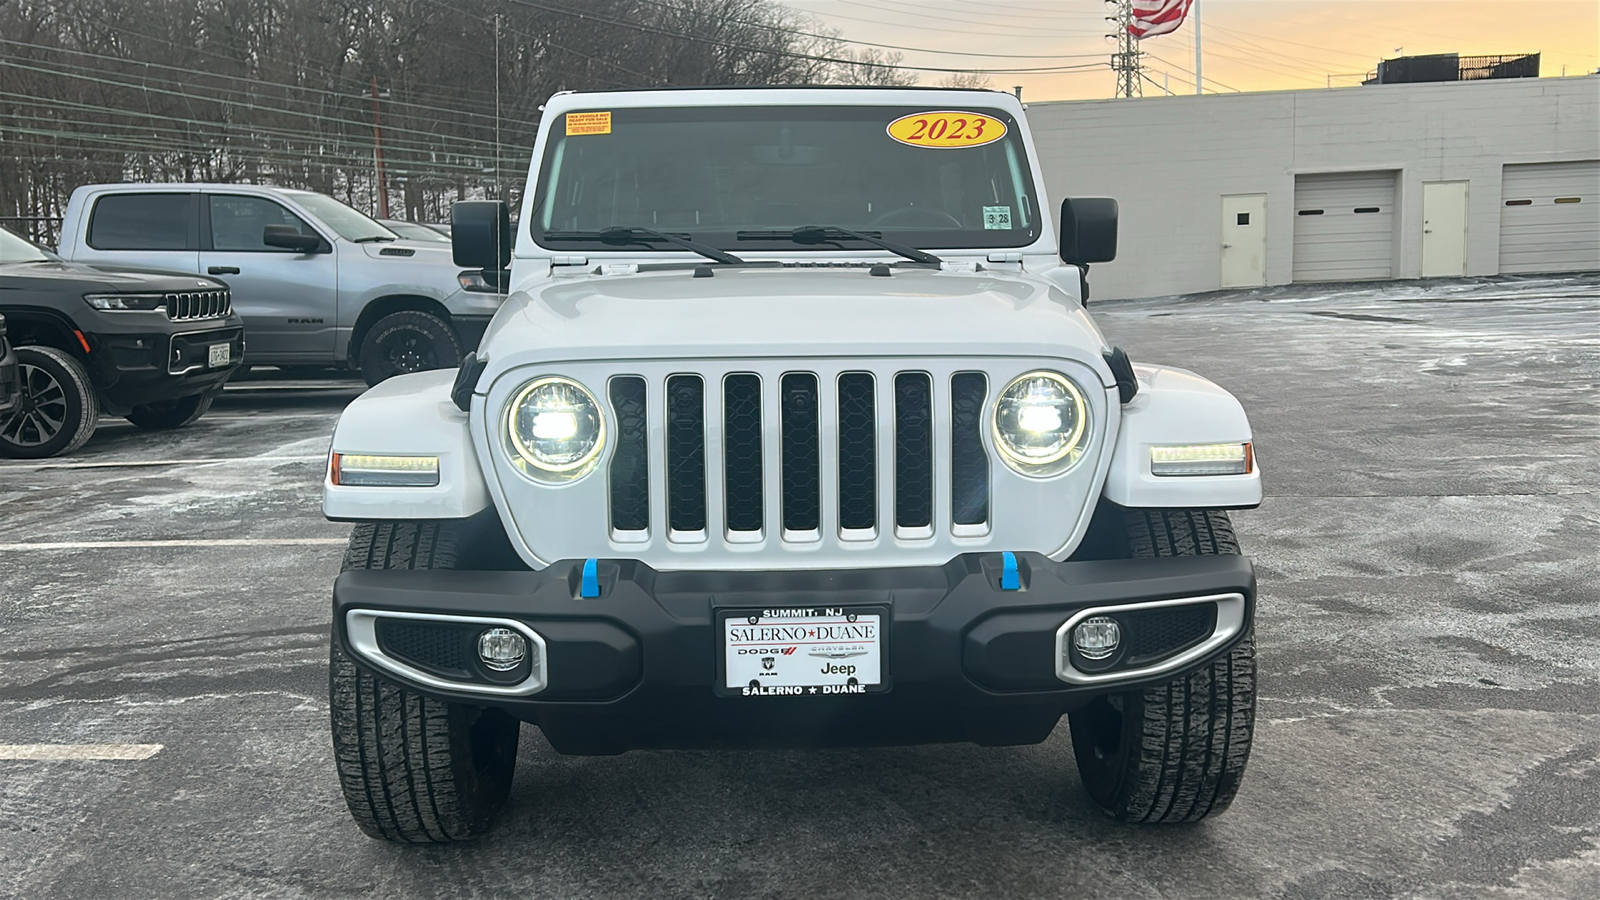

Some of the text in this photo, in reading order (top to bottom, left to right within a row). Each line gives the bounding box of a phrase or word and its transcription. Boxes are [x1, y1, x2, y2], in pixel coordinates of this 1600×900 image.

[906, 118, 986, 140] 2023
[999, 214, 1009, 223] 28
[762, 608, 843, 618] SUMMIT, NJ
[730, 625, 875, 642] SALERNO DUANE
[820, 662, 857, 676] Jeep
[742, 684, 866, 696] SALERNO DUANE
